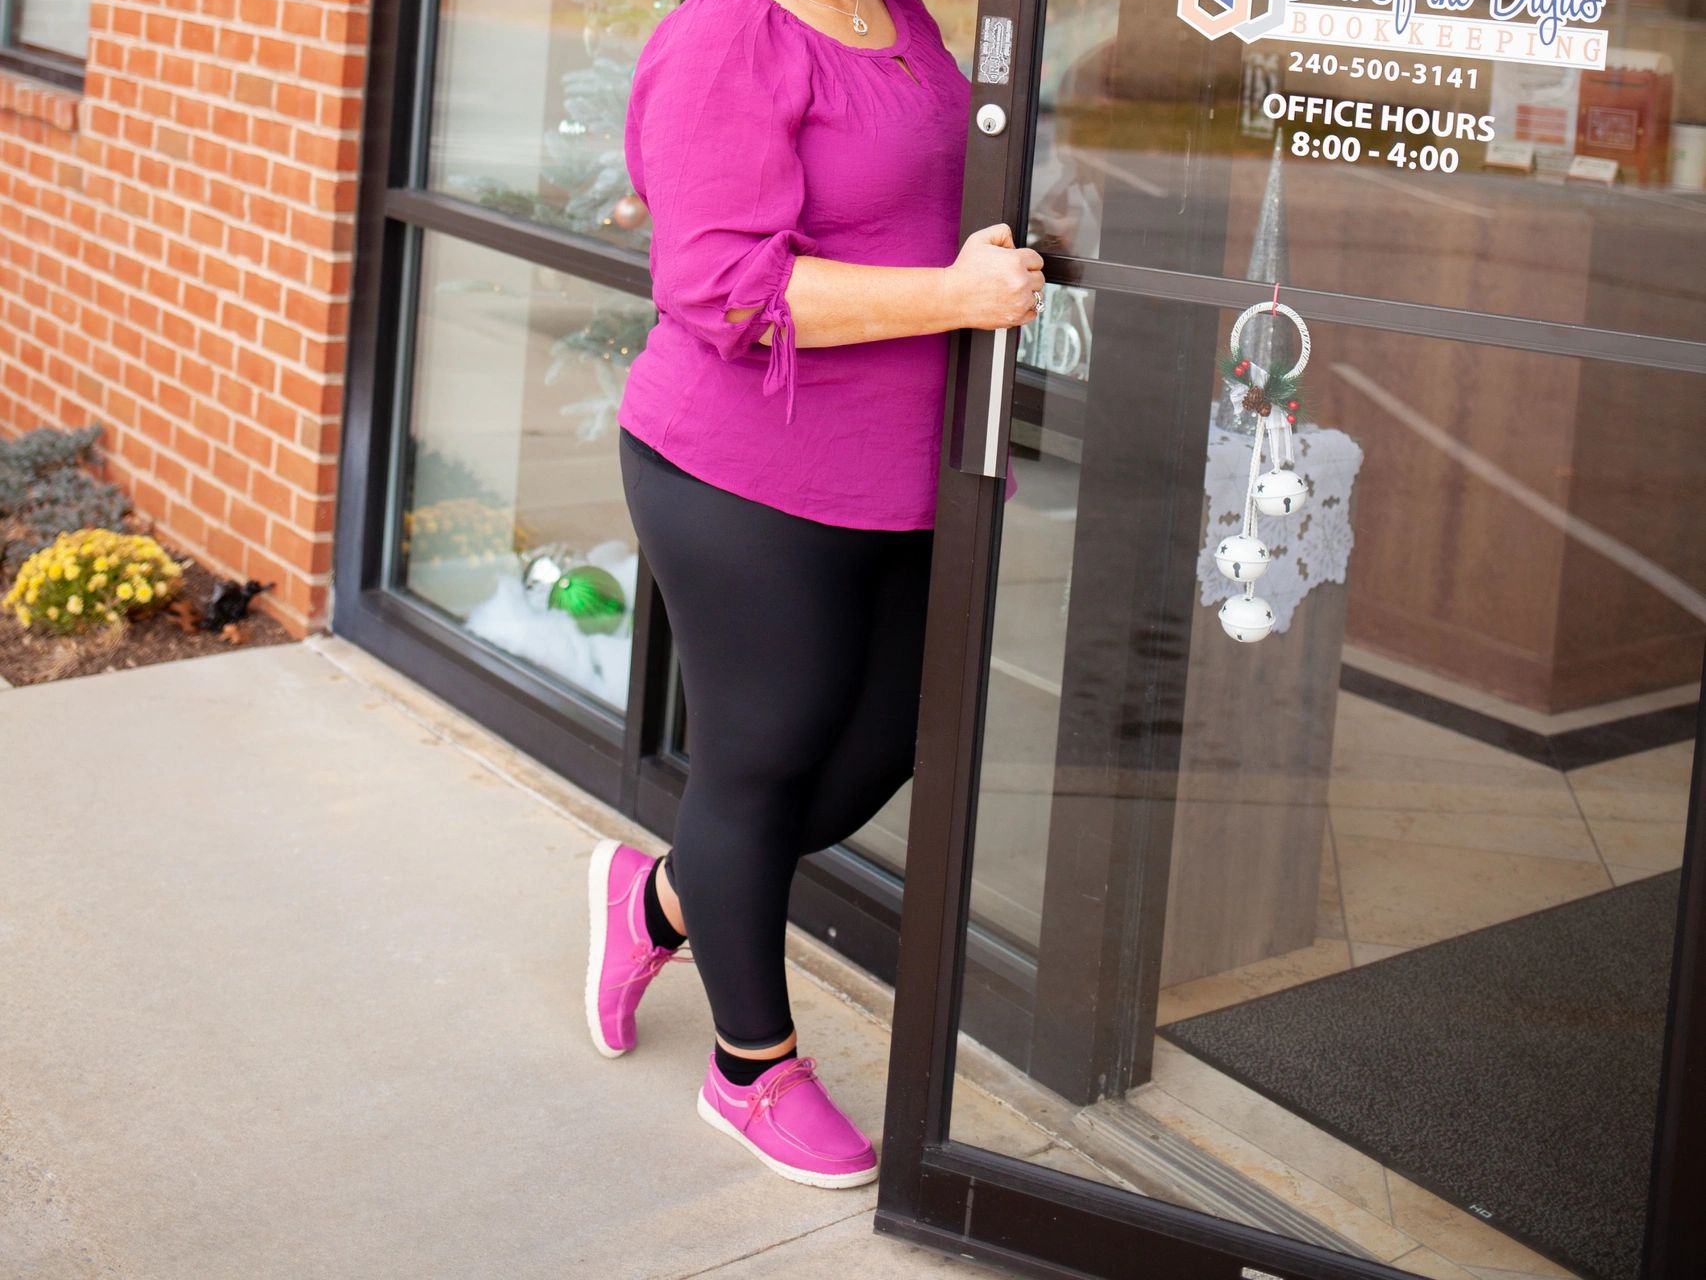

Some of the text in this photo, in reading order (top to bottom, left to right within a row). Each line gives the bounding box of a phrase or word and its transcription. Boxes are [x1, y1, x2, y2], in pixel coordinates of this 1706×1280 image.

[1291, 11, 1603, 63] BOOKKEEPING
[1288, 51, 1478, 90] 240-500-3141
[1263, 93, 1496, 142] OFFICE HOURS
[1291, 131, 1361, 162] 8:00
[1387, 142, 1459, 173] 4:00
